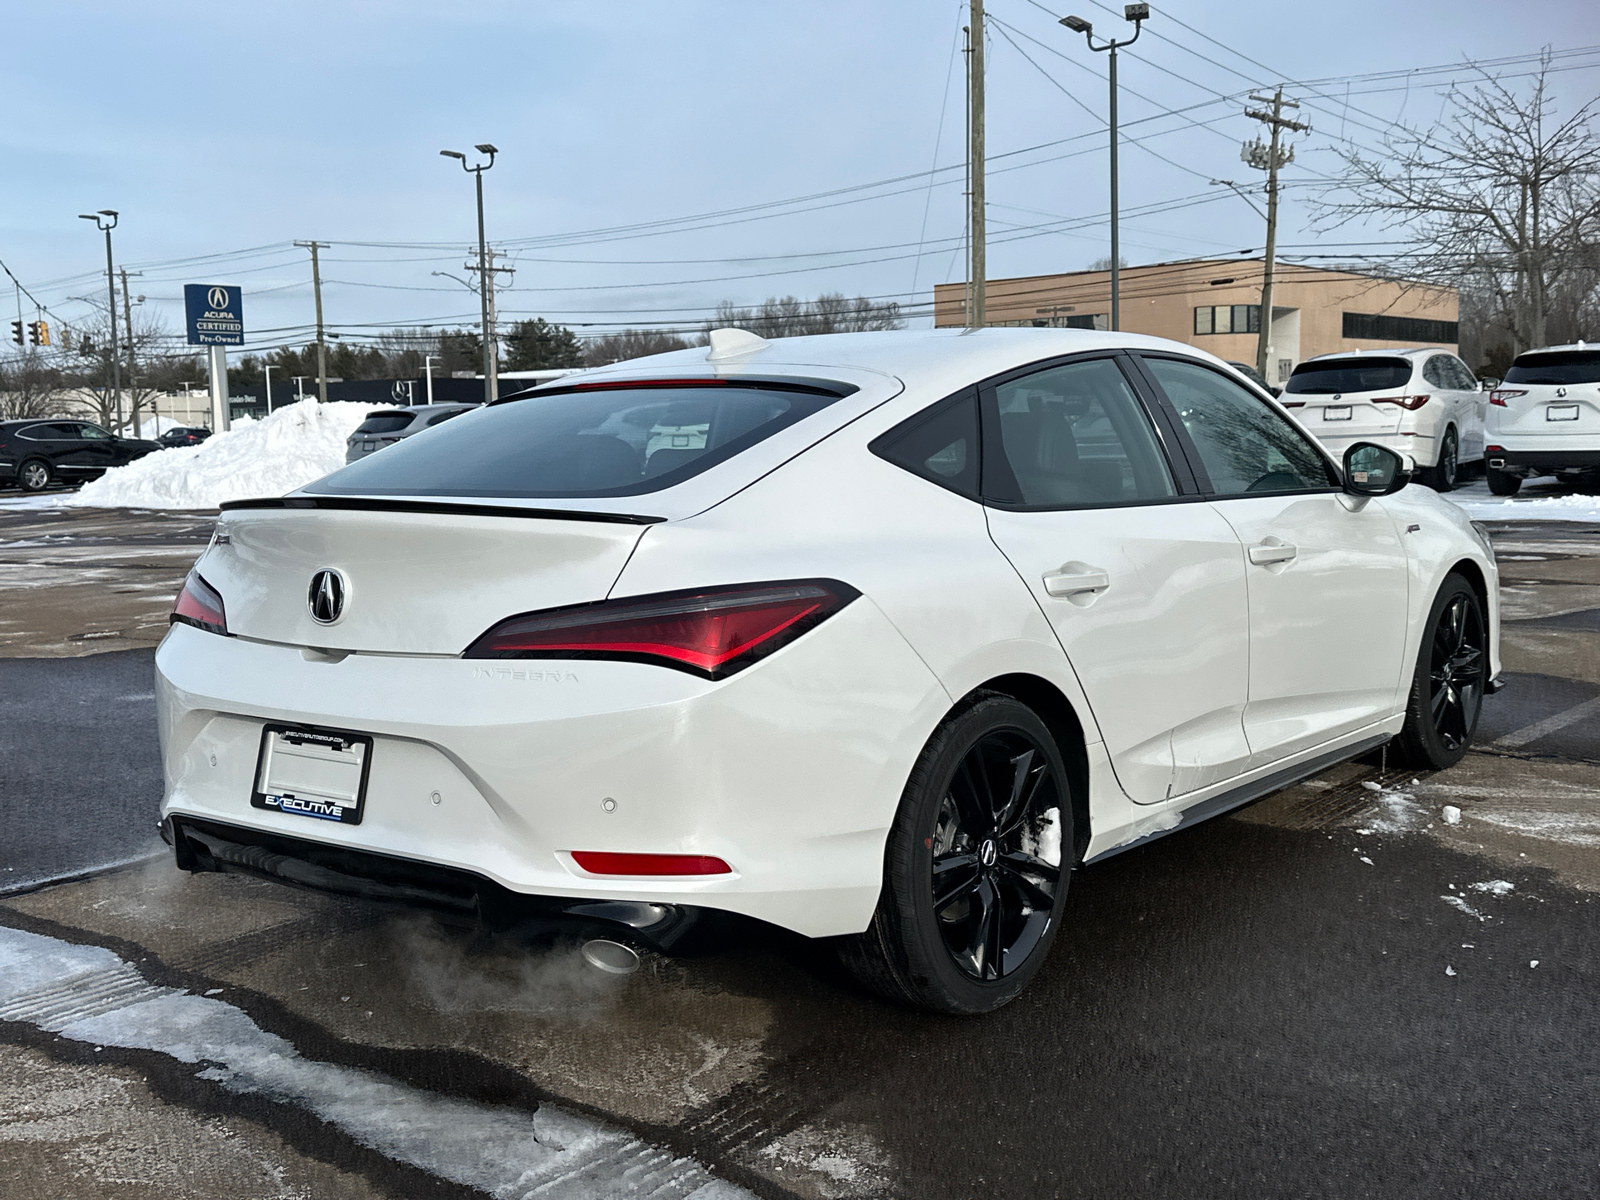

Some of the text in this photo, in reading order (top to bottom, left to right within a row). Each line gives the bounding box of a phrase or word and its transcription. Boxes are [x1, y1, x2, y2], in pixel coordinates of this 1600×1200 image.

[203, 311, 234, 319] ACURA
[196, 322, 241, 331] CERTIFIED
[199, 334, 240, 343] Pre-Owned
[472, 667, 579, 683] INTEGRA
[265, 795, 343, 816] EXECUTIVE
